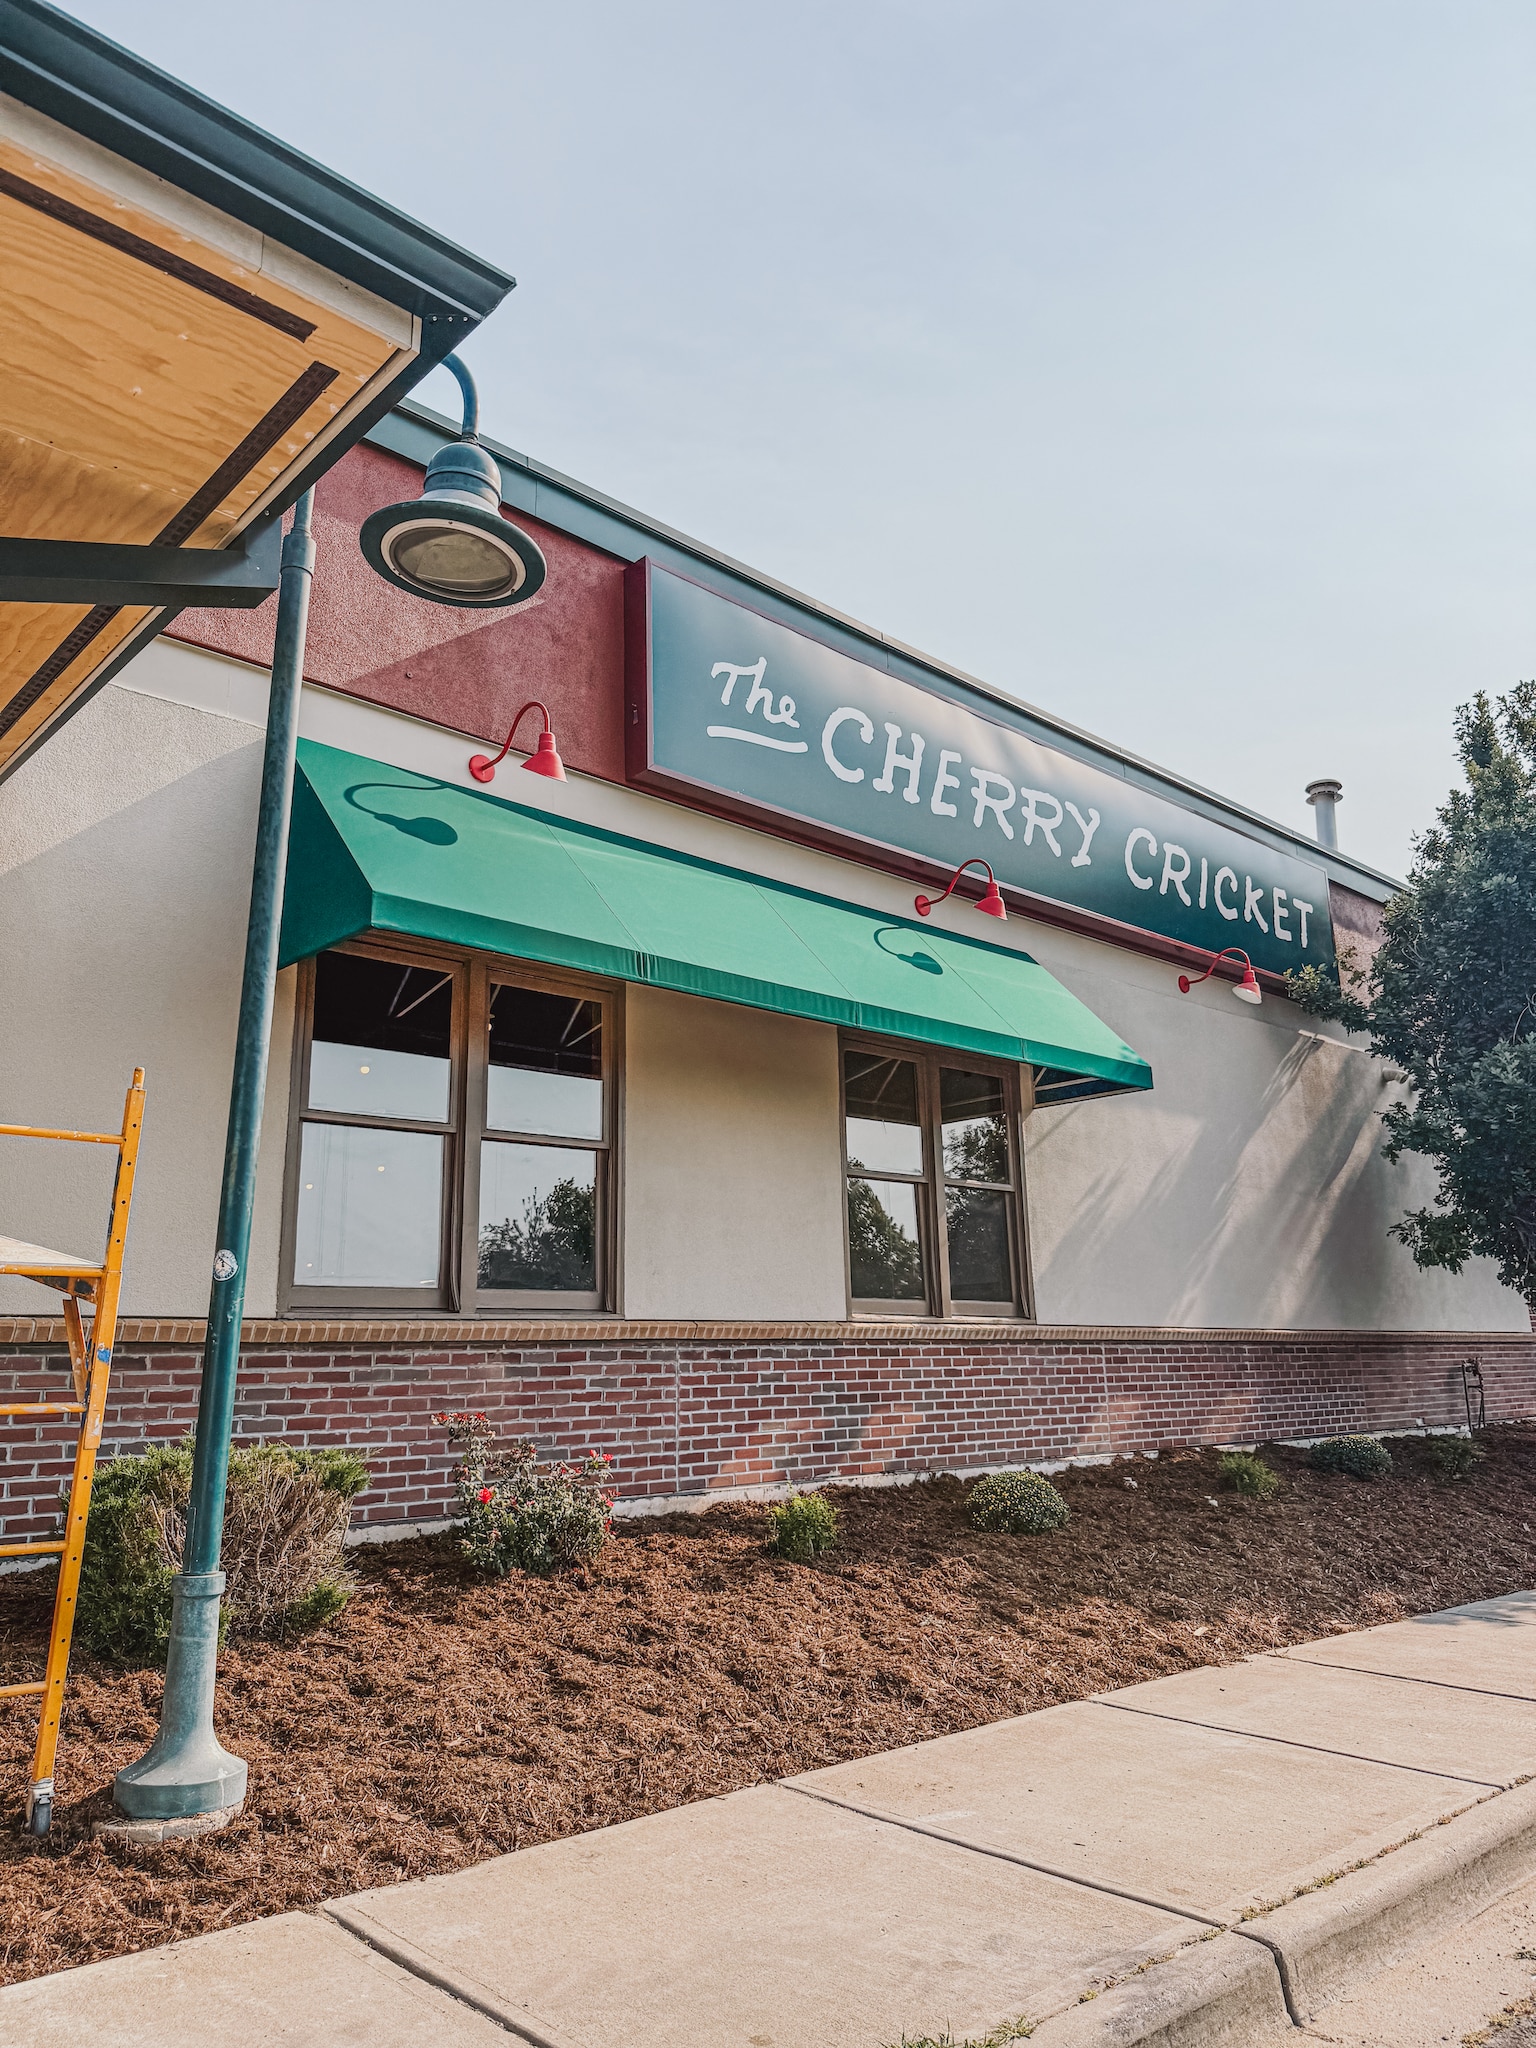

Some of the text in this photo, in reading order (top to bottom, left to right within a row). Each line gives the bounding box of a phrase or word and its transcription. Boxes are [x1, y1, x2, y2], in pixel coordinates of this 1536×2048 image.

[710, 656, 1314, 949] The CHERRY CRICKET
